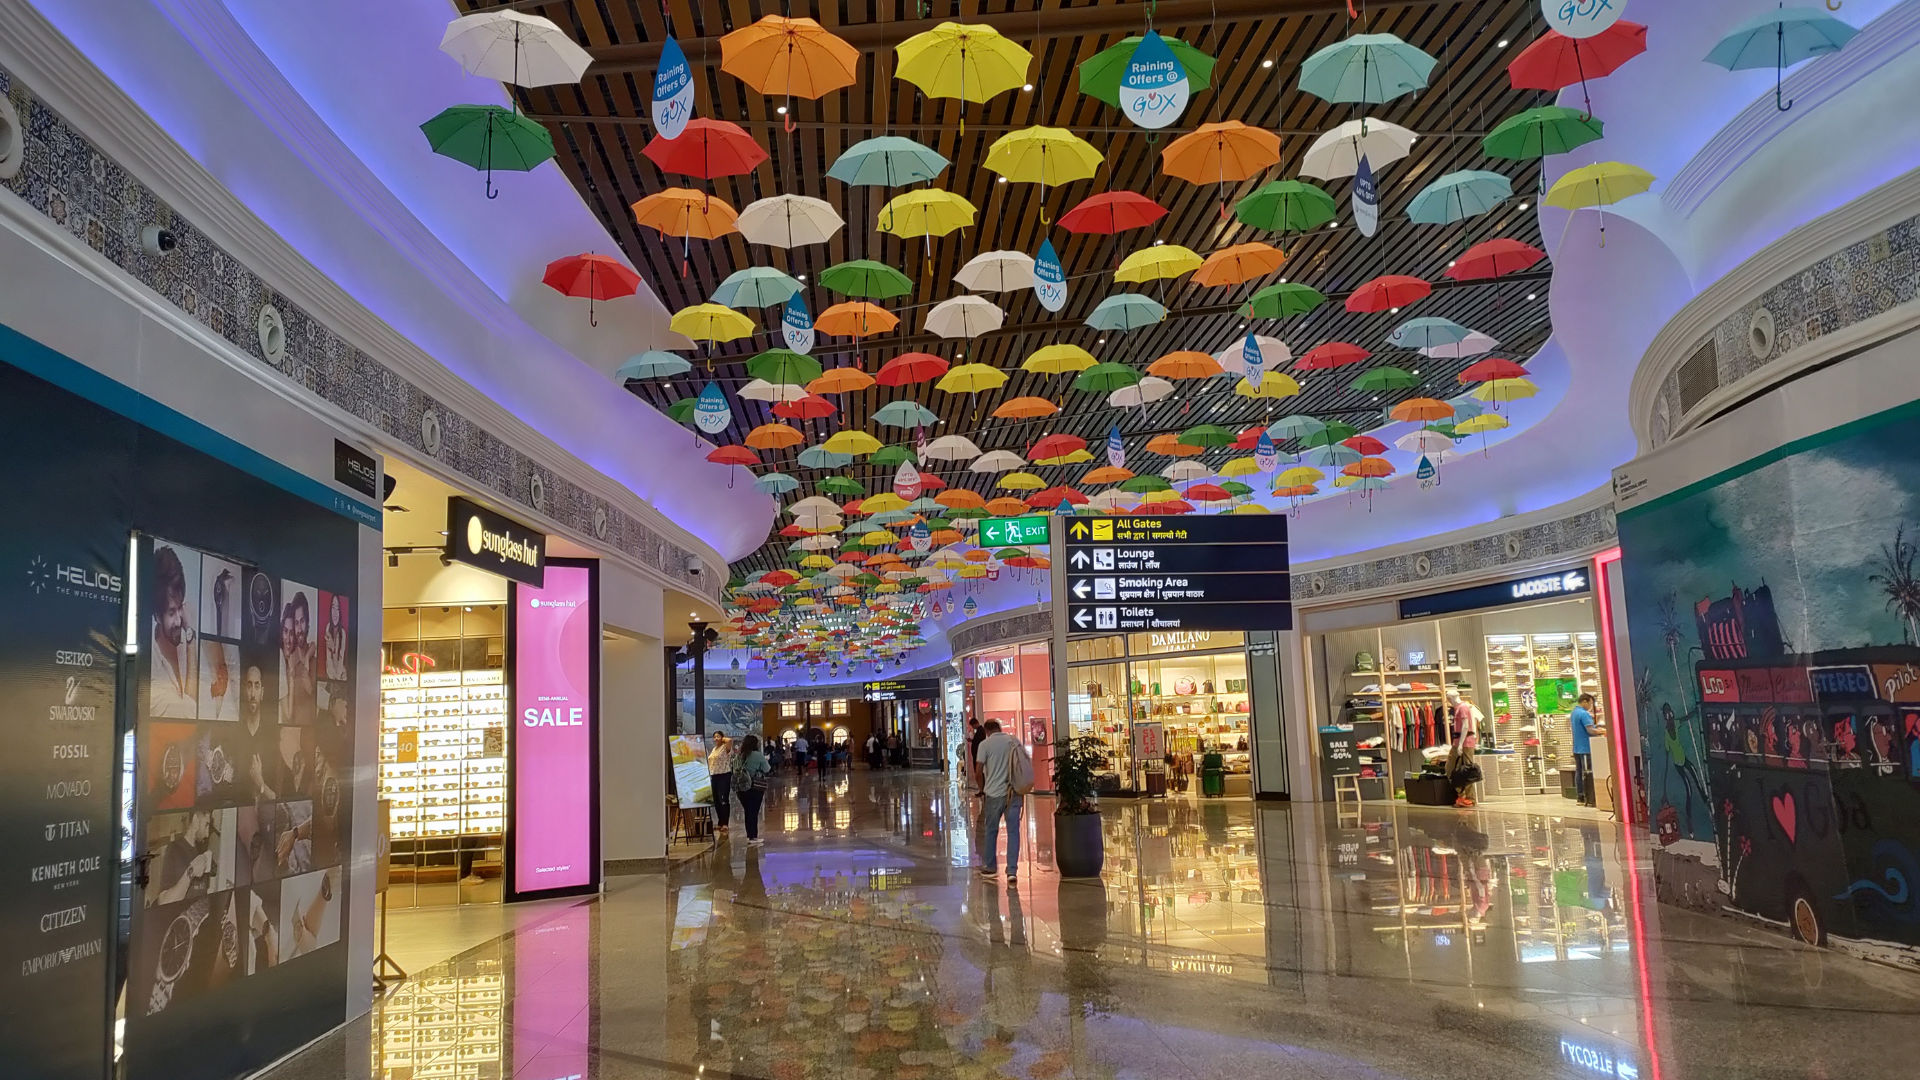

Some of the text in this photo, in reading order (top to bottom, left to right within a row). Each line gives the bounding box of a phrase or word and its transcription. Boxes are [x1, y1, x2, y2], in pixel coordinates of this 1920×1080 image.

[658, 63, 684, 84] Raining
[1132, 60, 1174, 73] Raining
[1128, 74, 1164, 85] Offers
[656, 80, 679, 98] Offers
[1036, 267, 1055, 279] Offers
[1038, 258, 1060, 273] Raining
[786, 315, 804, 326] Offers
[788, 307, 809, 321] Raining
[347, 457, 376, 480] HELIOS
[1025, 526, 1046, 536] EXIT
[1117, 519, 1162, 529] All Gates
[483, 530, 538, 568] sunglass hut
[1117, 548, 1155, 560] Lounge
[56, 563, 122, 593] HELIOS
[1118, 577, 1188, 588] Smoking Area
[56, 586, 70, 595] THE
[73, 590, 98, 600] WATCH
[1512, 577, 1562, 598] LACOSTE
[1119, 607, 1154, 617] Toilets
[55, 649, 93, 667] SEIKO
[1813, 672, 1869, 694] STEREO
[49, 705, 96, 722] SWAROVSKI
[523, 707, 583, 727] SALE
[53, 744, 89, 759] FOSSIL
[46, 779, 91, 800] MOVADO
[59, 819, 91, 839] TITAN
[31, 856, 100, 882] KENNETH COLE
[40, 904, 88, 933] CITIZEN
[22, 938, 102, 977] EMPORIO ARMANI
